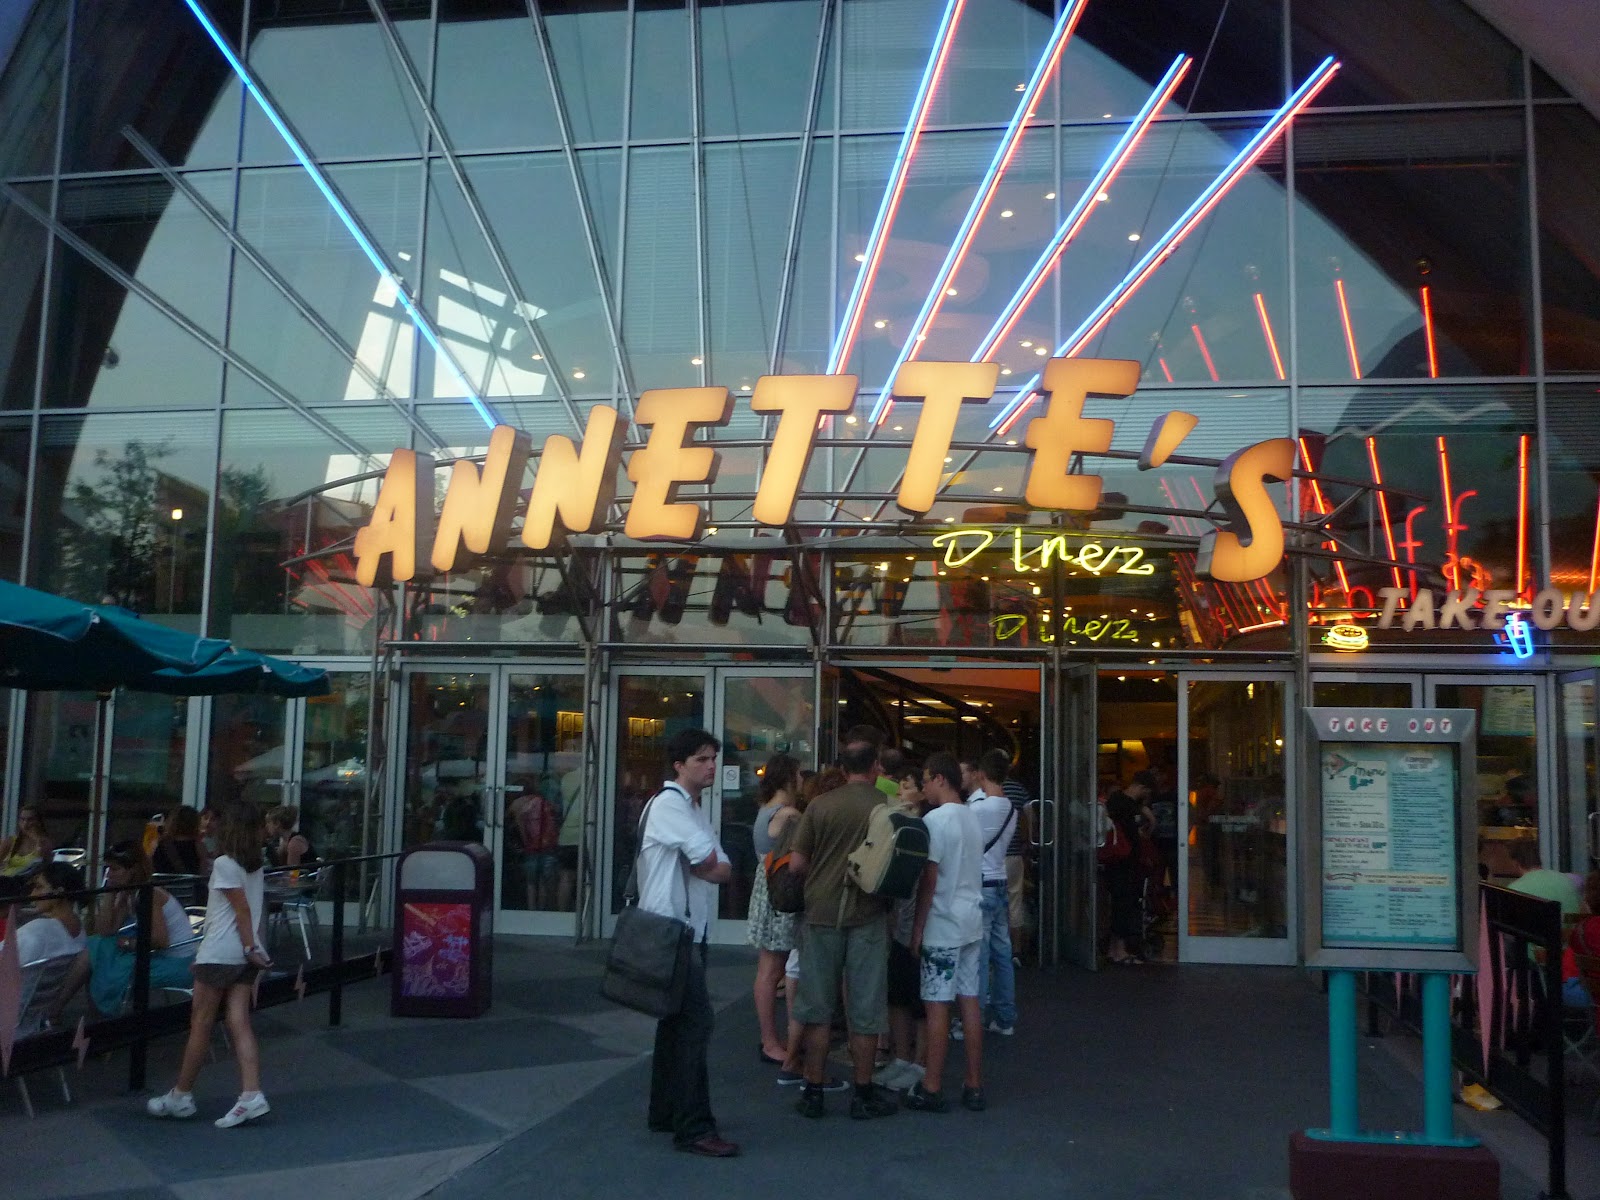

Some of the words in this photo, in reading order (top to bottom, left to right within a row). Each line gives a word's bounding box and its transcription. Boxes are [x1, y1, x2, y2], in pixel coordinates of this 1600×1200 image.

[1376, 586, 1516, 632] TAKE
[1532, 588, 1600, 632] OU
[1329, 718, 1389, 733] TAKE
[1408, 718, 1452, 733] OUT
